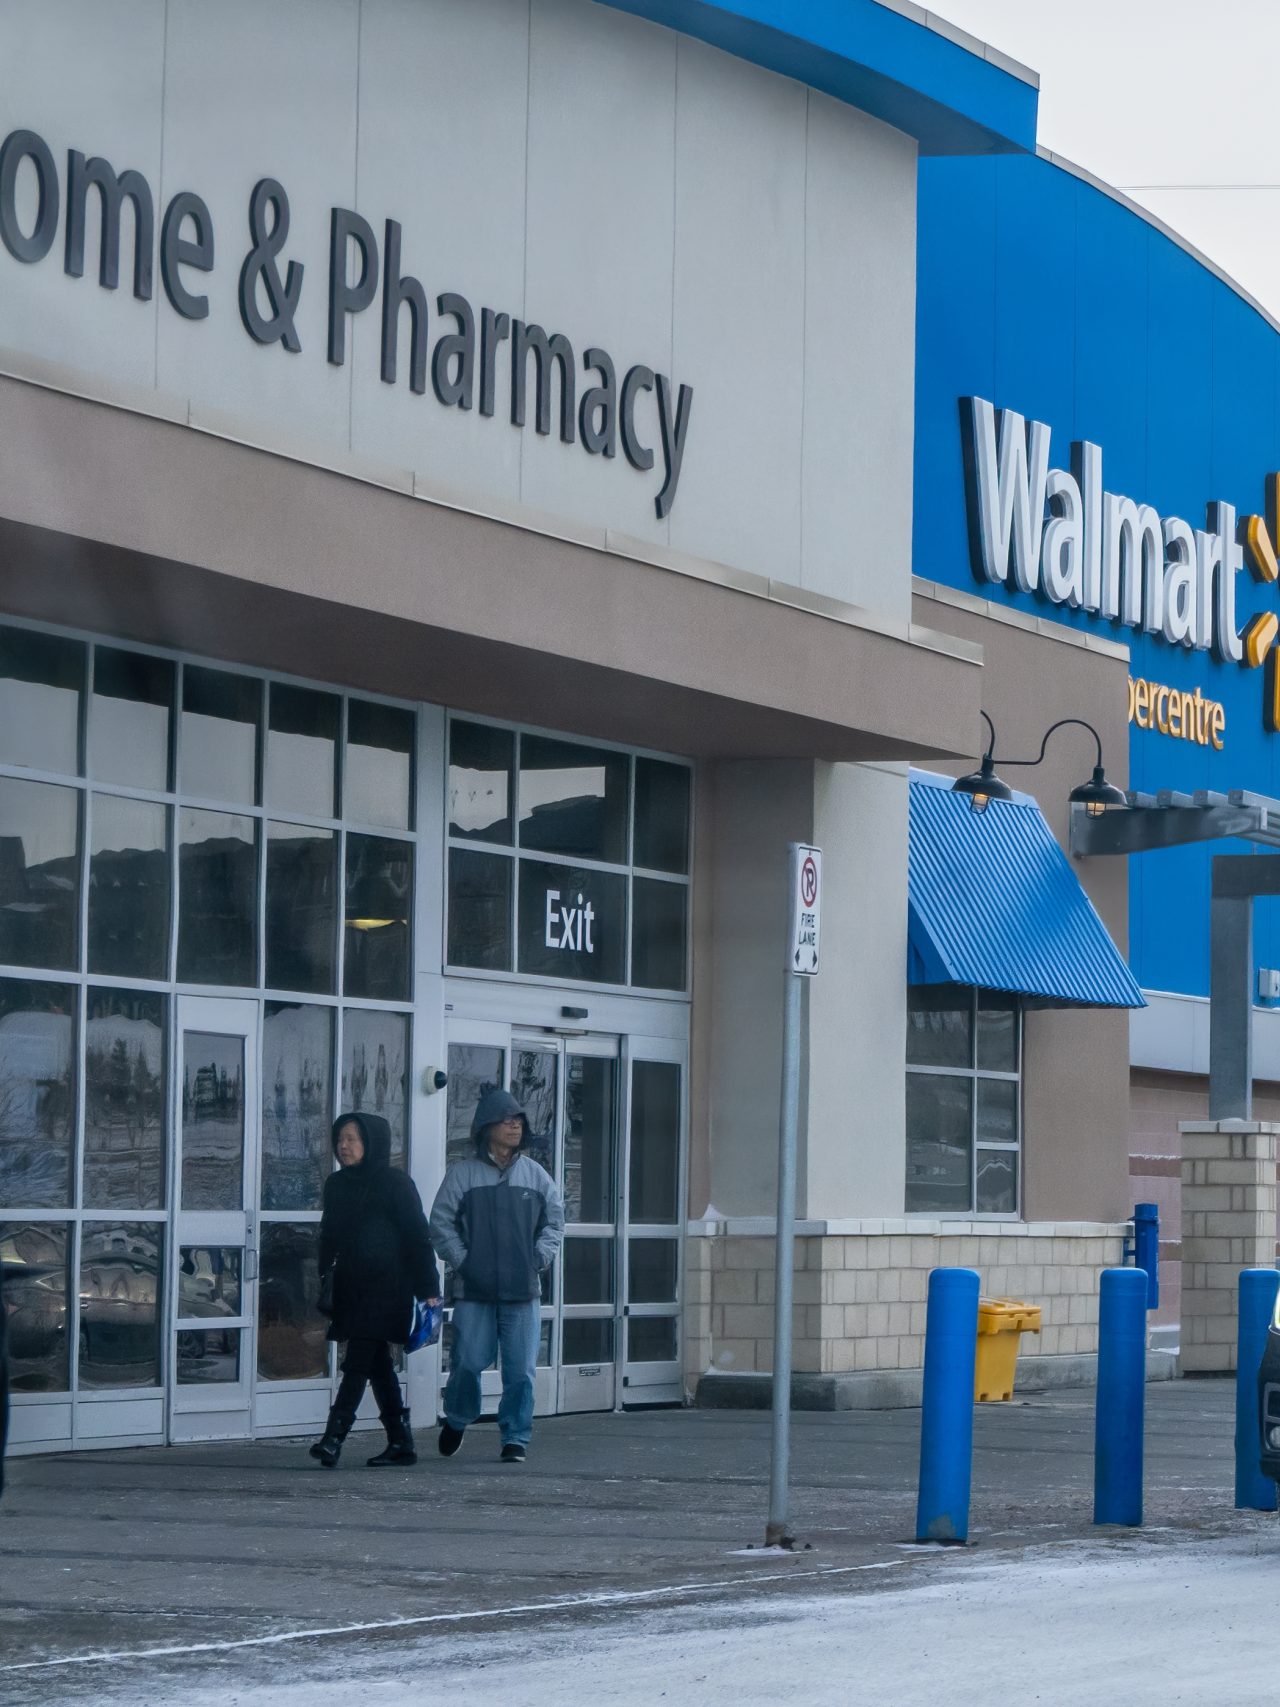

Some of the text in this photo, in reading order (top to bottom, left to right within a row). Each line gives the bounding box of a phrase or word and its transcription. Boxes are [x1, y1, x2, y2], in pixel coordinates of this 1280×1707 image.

[238, 178, 304, 352] &
[327, 207, 693, 519] Pharmacy
[960, 396, 1243, 663] Walmart
[546, 889, 594, 953] Exit
[799, 931, 816, 946] LANE
